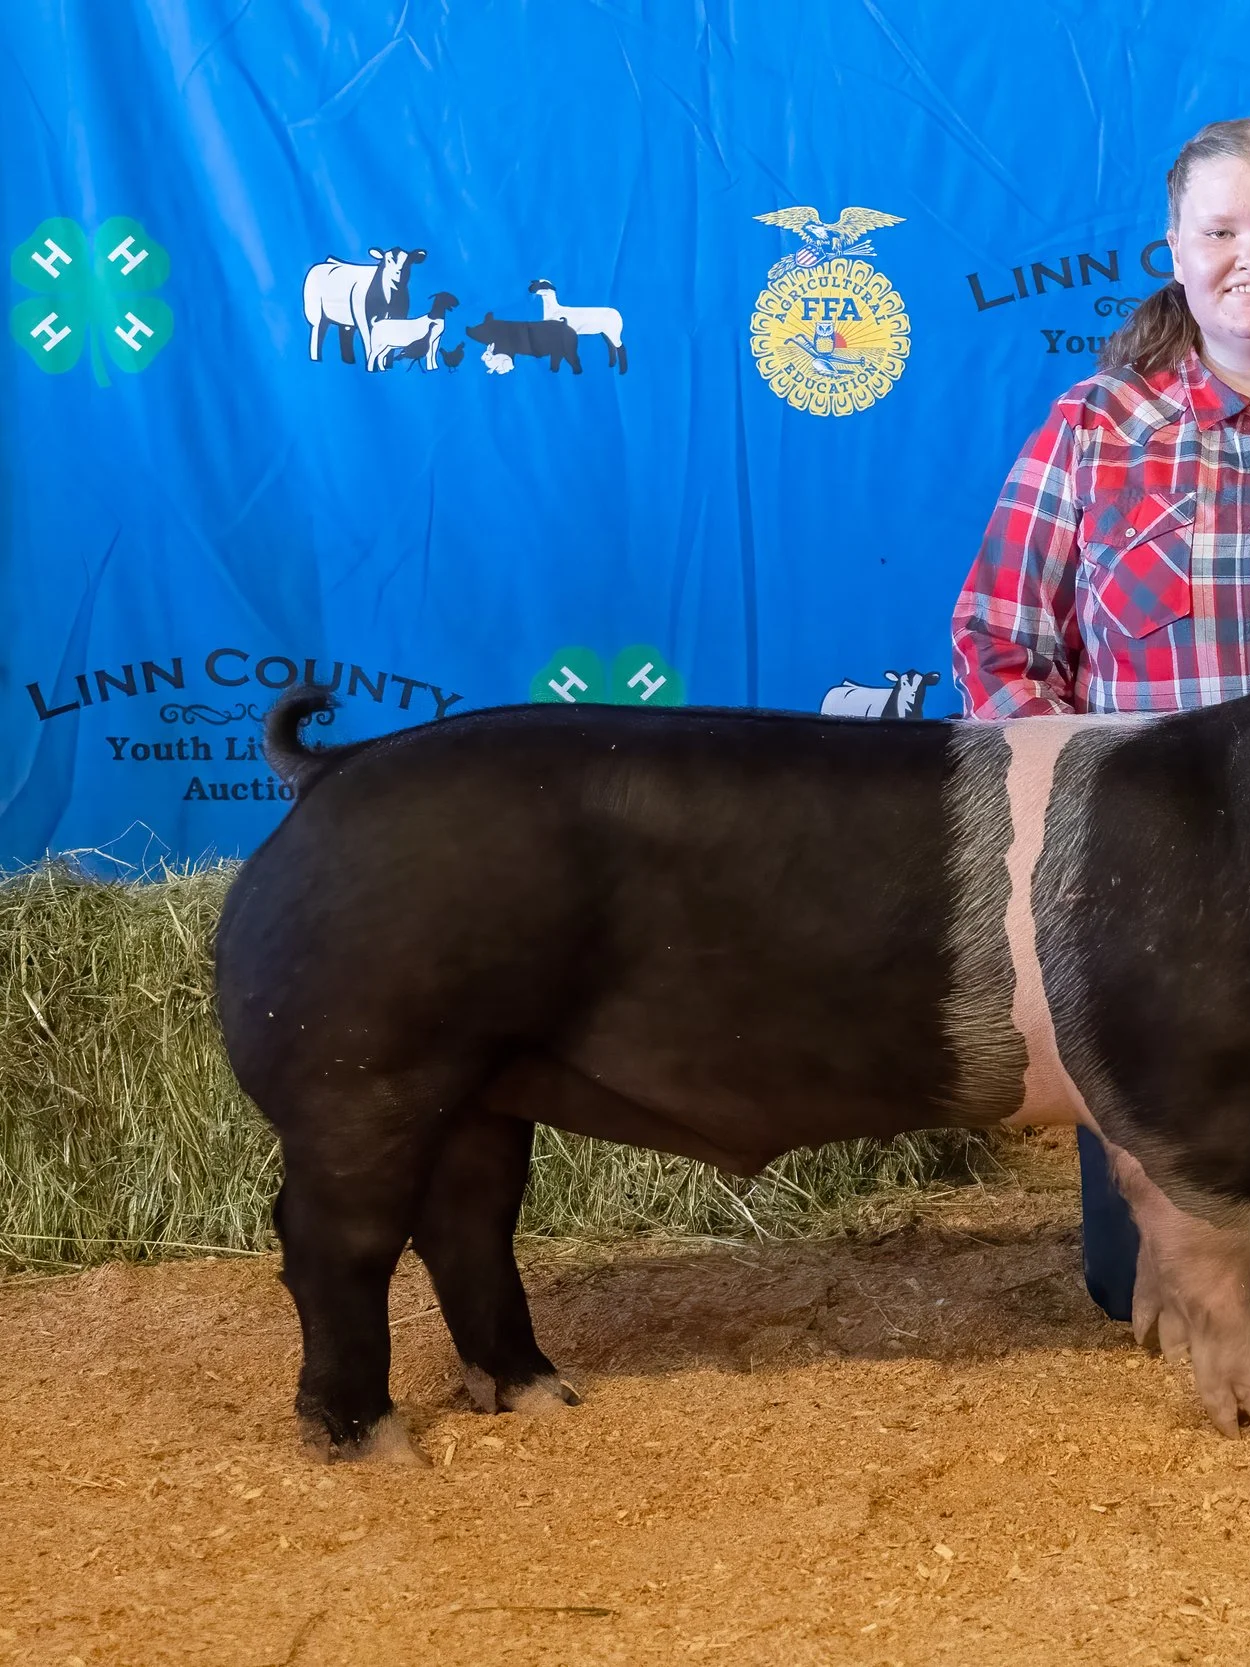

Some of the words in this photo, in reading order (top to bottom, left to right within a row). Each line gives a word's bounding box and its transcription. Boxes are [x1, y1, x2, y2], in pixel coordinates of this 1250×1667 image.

[31, 238, 72, 278] H
[107, 236, 149, 276] H
[774, 276, 886, 326] AGRICULTURAL
[965, 250, 1120, 312] LINN
[801, 297, 863, 322] FFA
[30, 312, 72, 352] H
[114, 312, 154, 351] H
[1041, 330, 1116, 354] You
[783, 362, 878, 394] EDUCATION
[26, 657, 185, 721] LINN
[205, 648, 464, 719] COUNTY
[548, 666, 588, 702] H
[627, 662, 667, 701] H
[106, 736, 212, 761] Youth
[183, 776, 295, 801] Auctio
